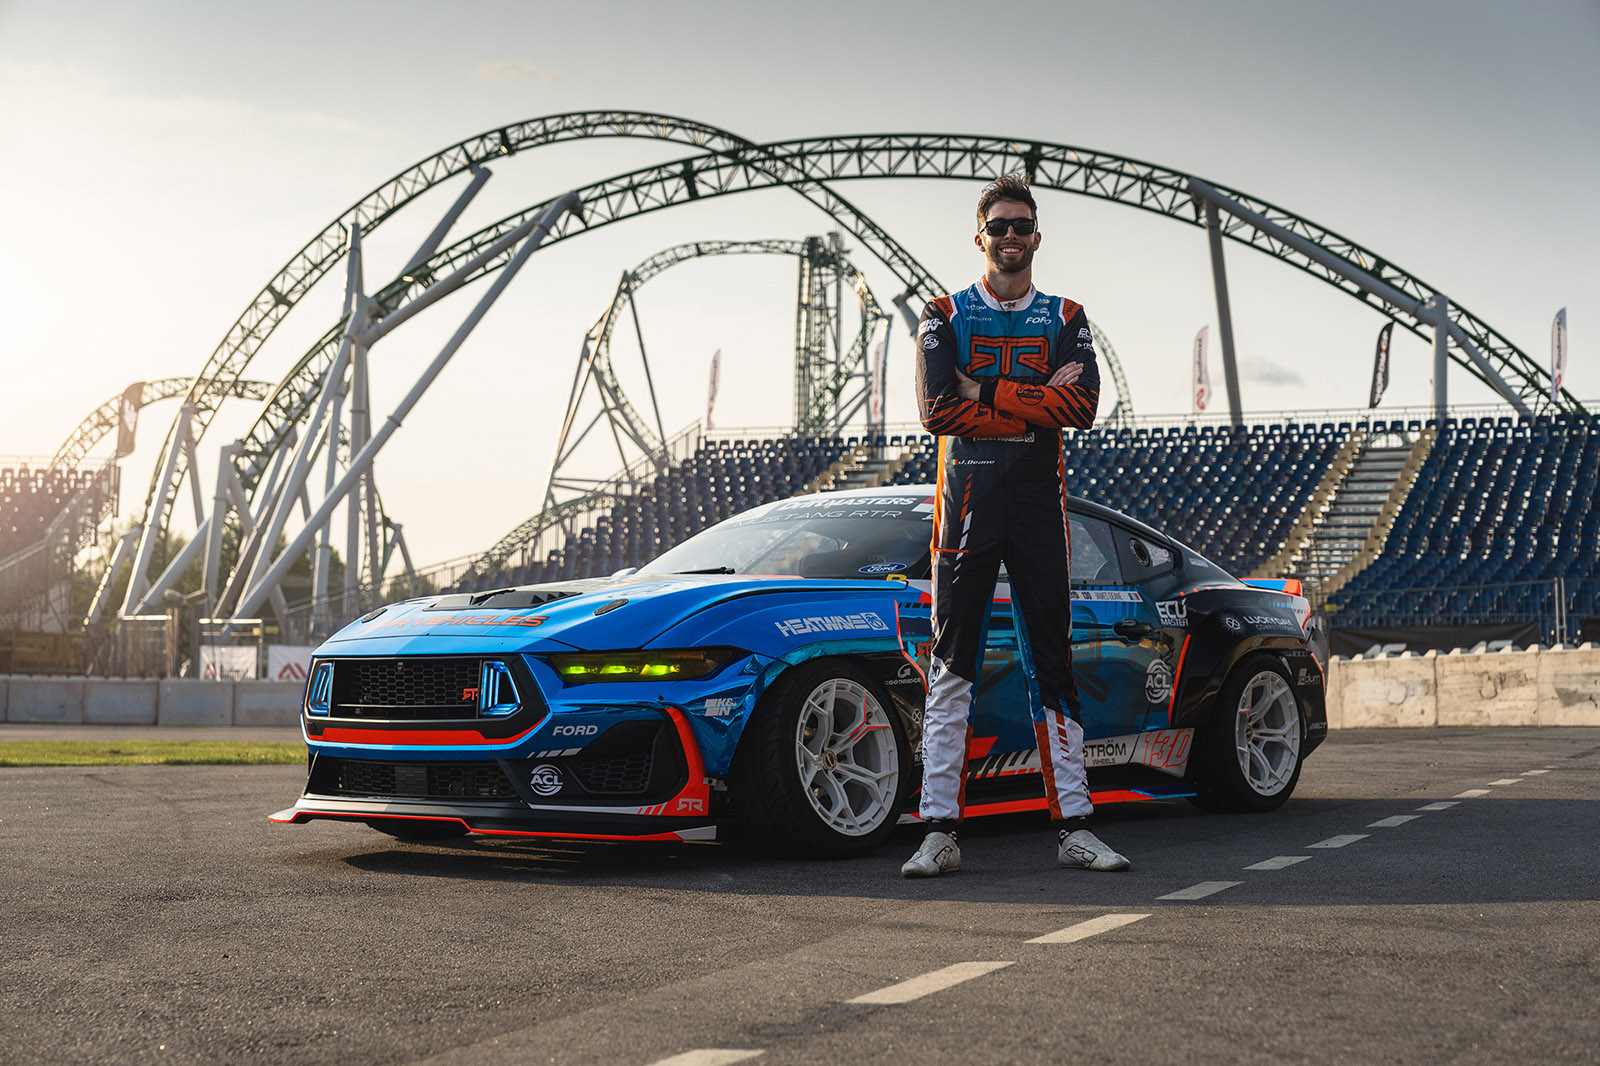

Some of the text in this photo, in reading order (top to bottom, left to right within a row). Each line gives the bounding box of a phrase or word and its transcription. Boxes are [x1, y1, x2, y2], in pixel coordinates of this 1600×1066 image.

[965, 334, 1053, 375] RTR
[849, 509, 903, 519] RTR
[866, 563, 899, 574] Ford
[1155, 598, 1188, 619] ECU
[413, 616, 550, 628] VEHICLES
[774, 615, 870, 637] HEATWAVE
[1160, 618, 1189, 626] MASTER
[1145, 674, 1171, 688] ACL
[552, 725, 599, 736] FORD
[1144, 728, 1190, 768] 130
[1092, 757, 1116, 766] WHEELS
[530, 774, 563, 786] ACL
